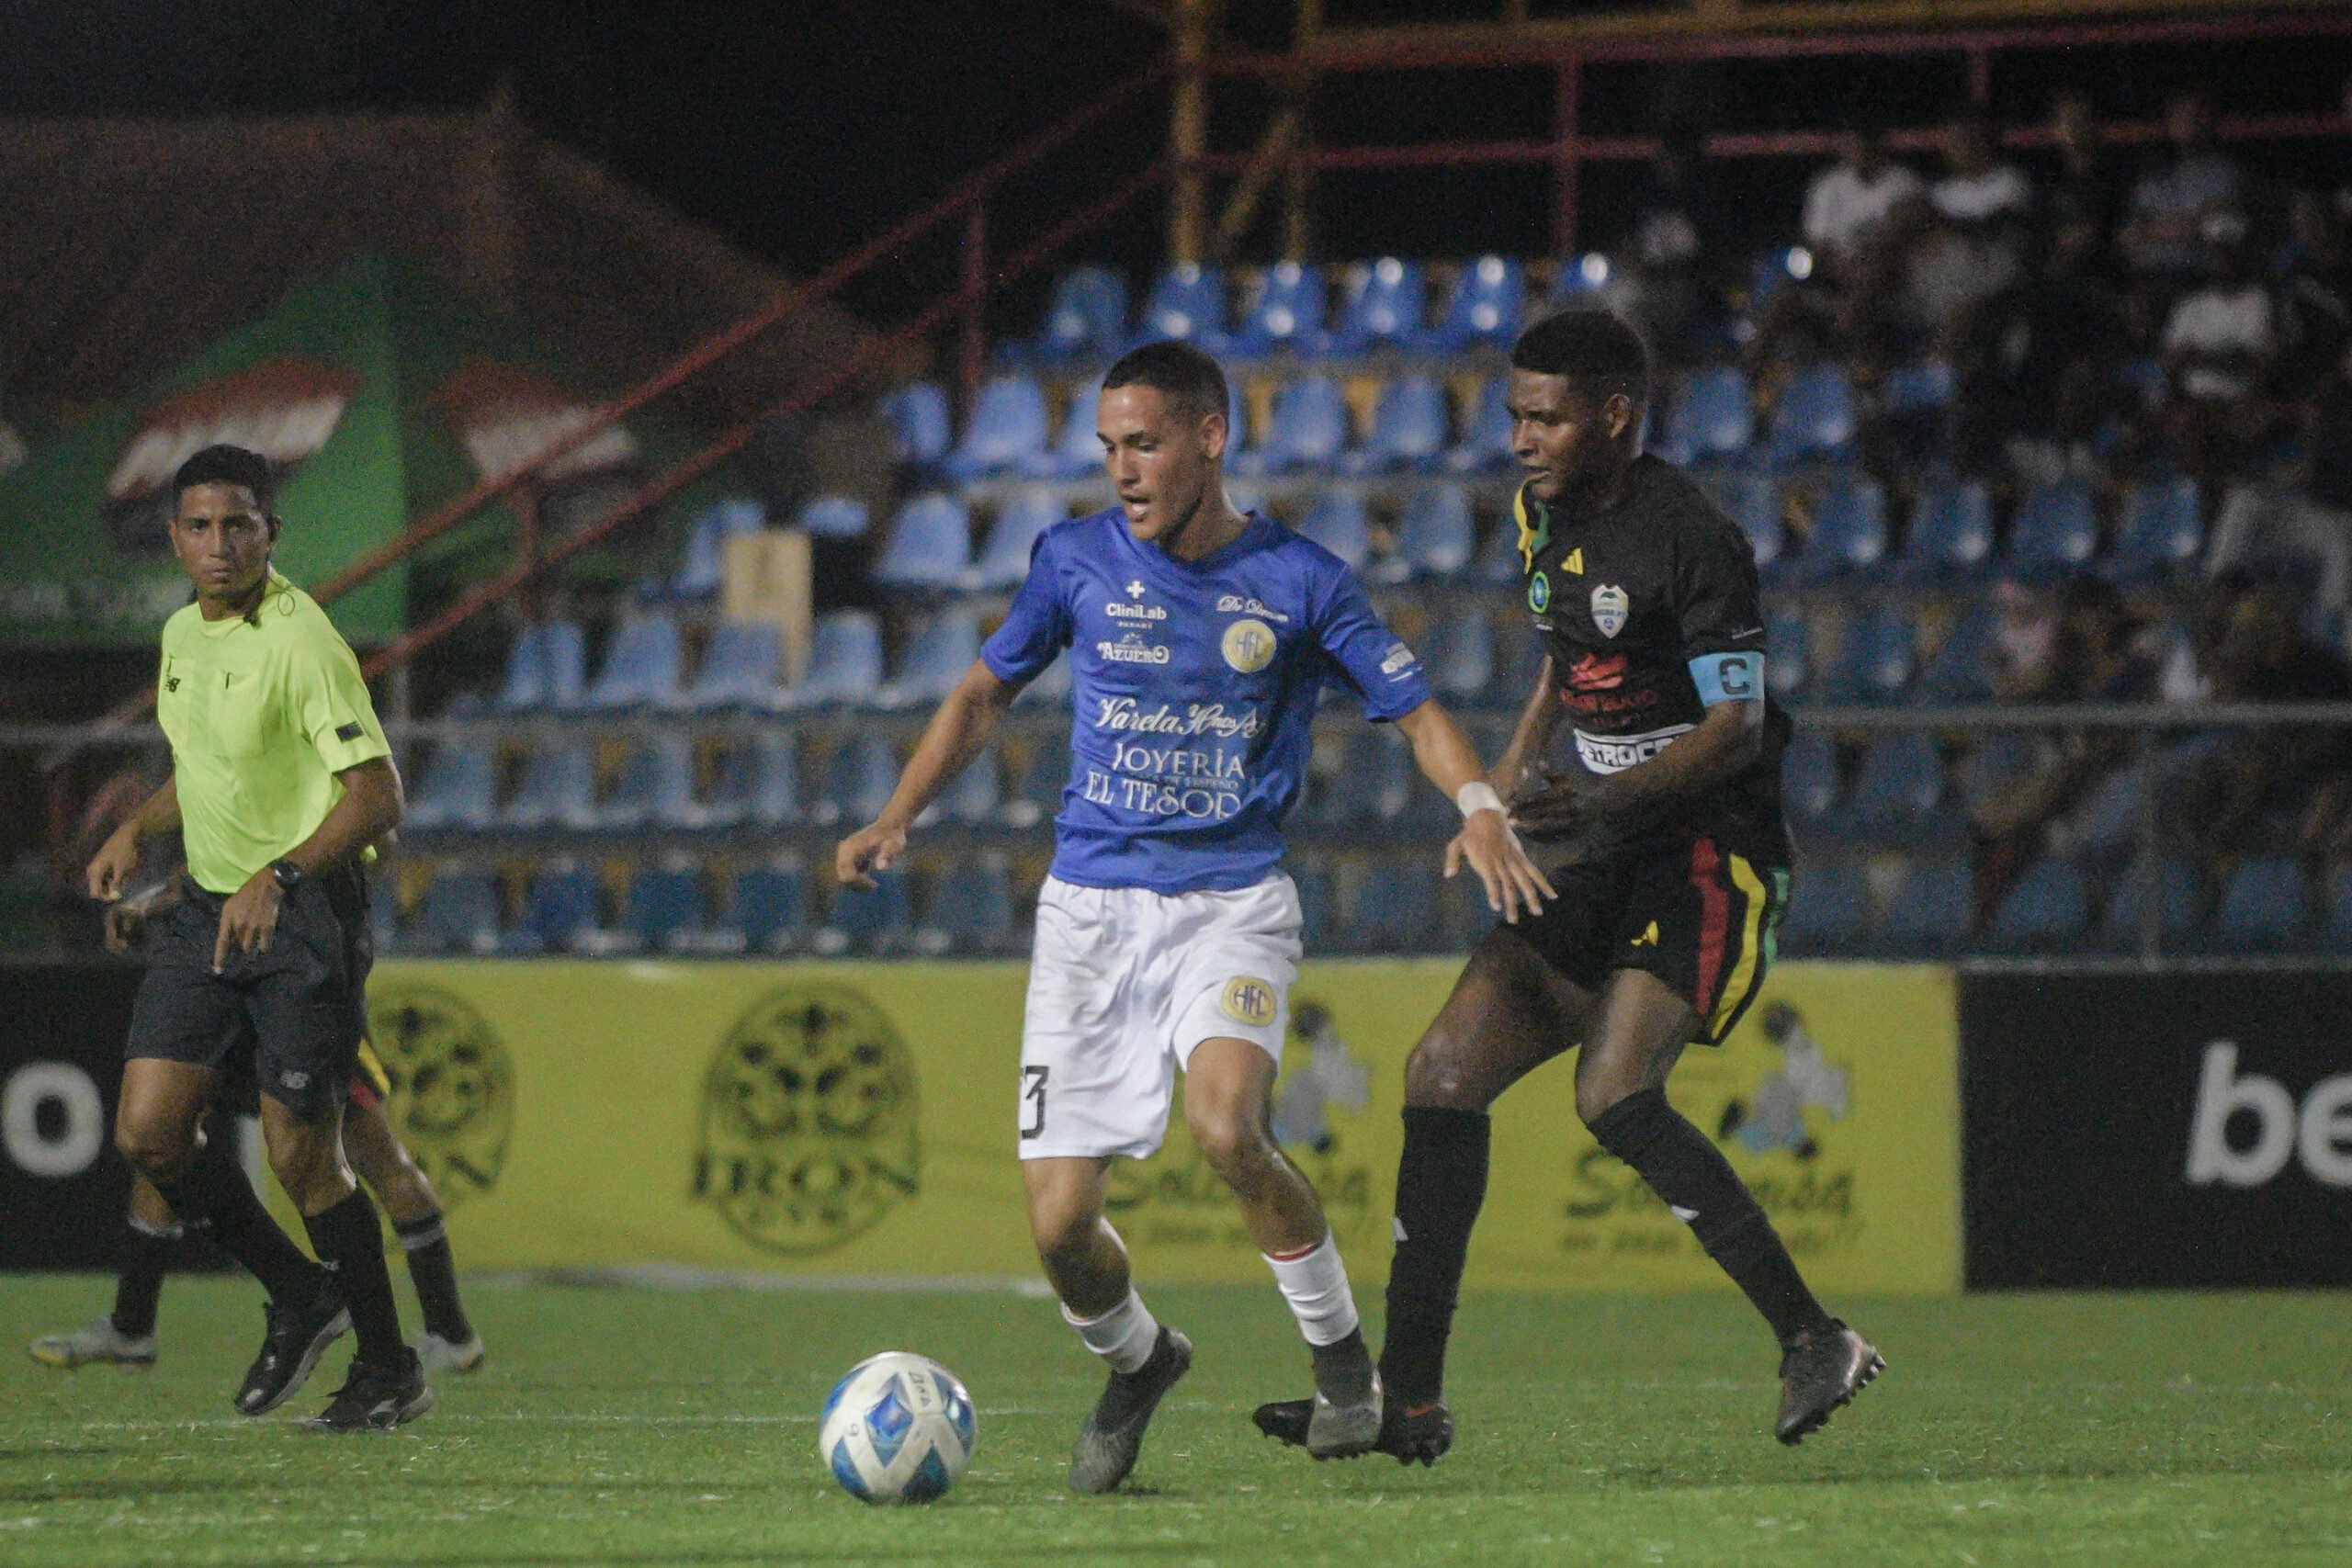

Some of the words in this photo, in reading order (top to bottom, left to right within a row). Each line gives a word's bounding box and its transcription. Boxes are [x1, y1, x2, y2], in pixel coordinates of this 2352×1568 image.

[1105, 603, 1167, 620] CliniLab
[1719, 657, 1751, 695] C
[1084, 771, 1115, 807] EL
